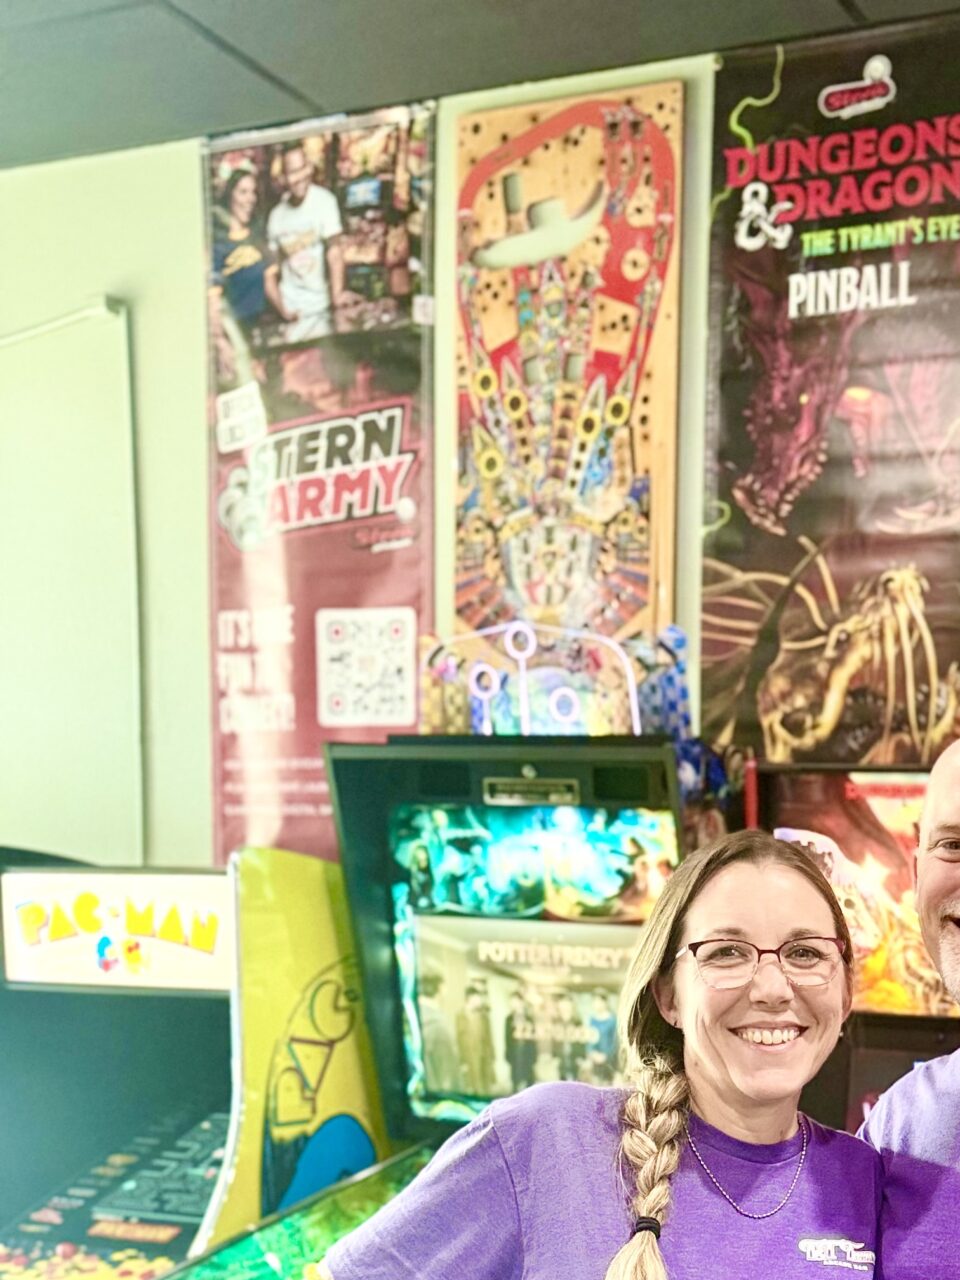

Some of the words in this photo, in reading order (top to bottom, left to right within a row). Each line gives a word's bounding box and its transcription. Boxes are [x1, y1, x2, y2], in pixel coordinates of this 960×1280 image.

[734, 182, 794, 251] &
[801, 229, 835, 257] THE
[839, 217, 924, 252] TYRANT'S
[788, 260, 918, 319] PINBALL
[253, 410, 401, 488] STERN
[266, 456, 412, 528] ARMY
[16, 891, 219, 956] PAC-MAN
